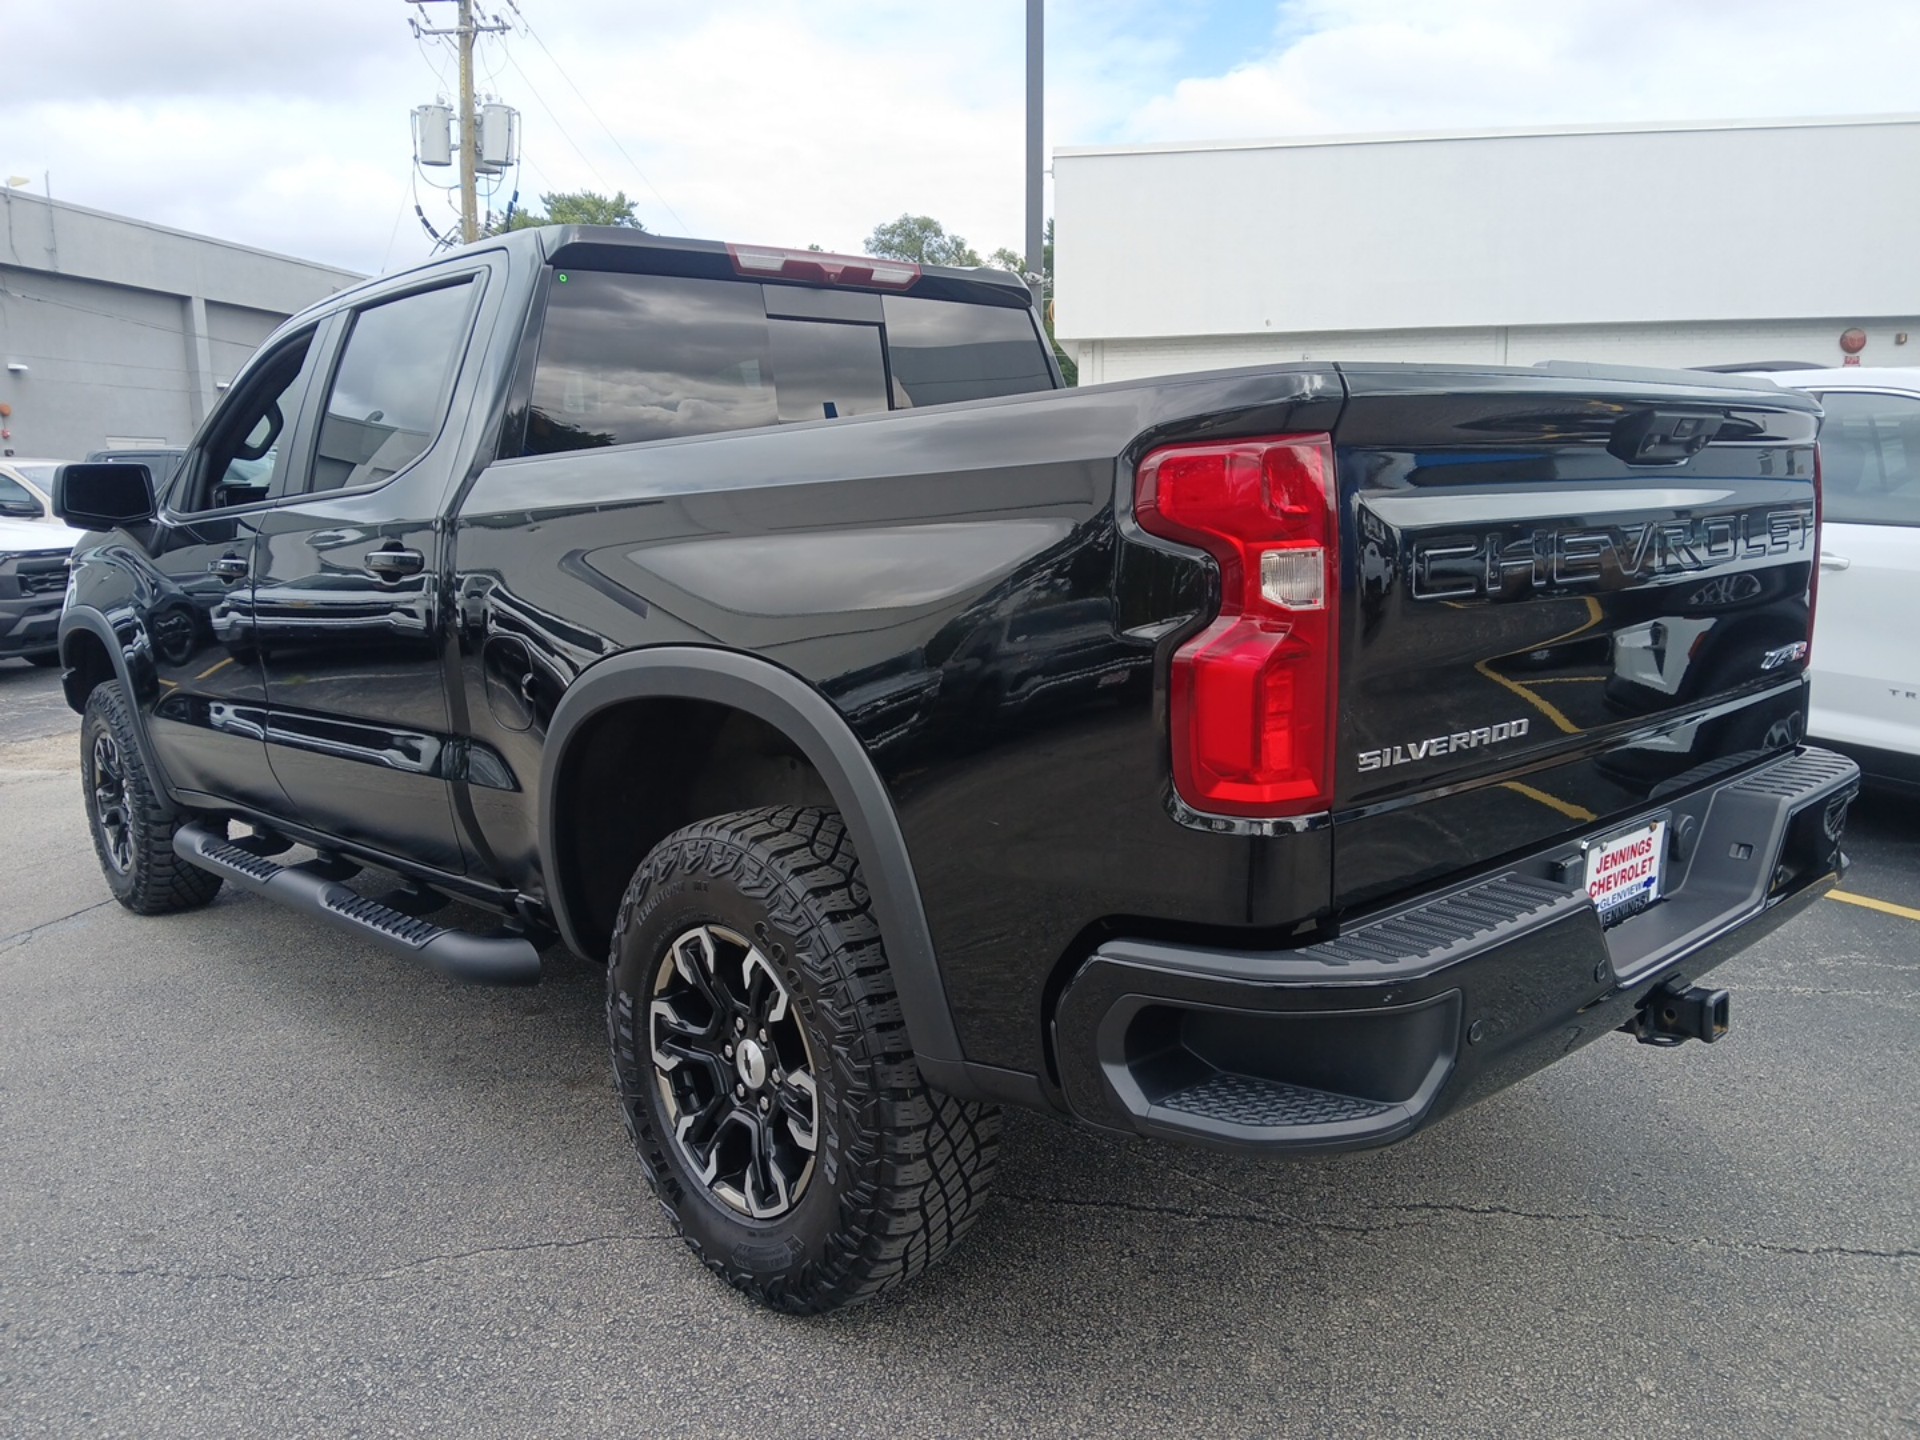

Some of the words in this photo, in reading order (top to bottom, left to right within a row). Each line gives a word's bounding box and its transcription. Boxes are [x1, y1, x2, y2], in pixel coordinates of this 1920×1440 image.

[1411, 508, 1812, 600] CHEVROLET
[1357, 717, 1530, 773] SILVERADO
[1588, 855, 1655, 898] CHEVROLET
[1595, 836, 1652, 874] JENNINGS
[1599, 880, 1645, 910] GLENVIEW
[753, 919, 840, 1186] GOODYEAR
[617, 990, 687, 1211] WRANGLER
